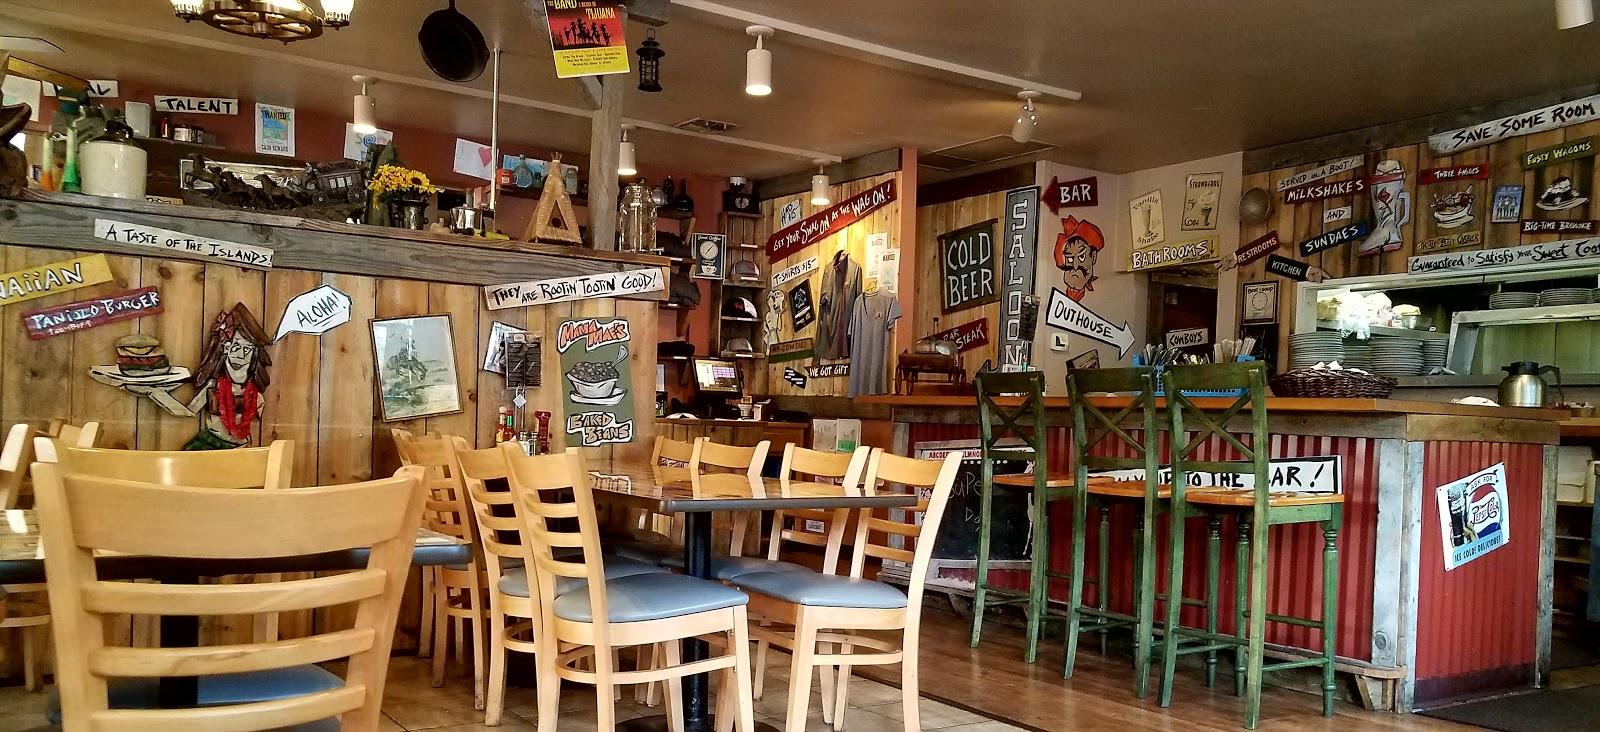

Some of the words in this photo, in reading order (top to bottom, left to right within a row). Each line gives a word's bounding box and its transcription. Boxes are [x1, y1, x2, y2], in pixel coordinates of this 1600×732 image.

[585, 7, 616, 19] TIJUANA
[160, 98, 233, 114] TALENT
[1452, 127, 1492, 148] SAVE
[1499, 112, 1546, 137] SOME
[1551, 102, 1596, 124] ROOM
[1527, 152, 1549, 165] RUSTY
[1280, 174, 1307, 189] SERVED
[1328, 158, 1354, 175] BOOT!
[1060, 184, 1091, 204] BAR
[773, 239, 785, 251] GET
[786, 230, 801, 248] YOUR
[800, 220, 819, 244] SWAG
[820, 215, 831, 234] ON
[831, 211, 839, 221] AT
[839, 204, 851, 215] THE
[851, 194, 870, 217] WAG
[1327, 210, 1346, 220] AND
[105, 224, 117, 242] A
[123, 229, 157, 245] TASTE
[166, 238, 181, 248] OF
[183, 239, 202, 251] THE
[208, 243, 273, 266] ISLANDS!
[1237, 237, 1277, 263] RESTROOMS
[1305, 224, 1359, 252] SUNDAES
[947, 232, 991, 271] COLD
[1132, 240, 1208, 269] BATHROOMS
[1412, 255, 1465, 271] Guaranteed
[1476, 250, 1514, 265] Satisfy
[1272, 260, 1302, 276] KITCHEN
[491, 285, 521, 306] THEY
[521, 290, 538, 304] ARE
[621, 272, 657, 291] GOOD!
[947, 268, 993, 308] BEER
[1005, 200, 1028, 365] SALOON
[100, 291, 160, 315] BURGER
[296, 292, 346, 327] ALOHA!
[1055, 301, 1114, 339] OUTHOUSE
[560, 321, 599, 348] MAMA
[955, 323, 986, 350] STEAK
[1169, 331, 1203, 349] COWBOYS
[809, 367, 819, 377] WE
[820, 366, 832, 376] GOT
[569, 414, 613, 430] BAKED
[585, 424, 629, 444] BEANS
[1471, 479, 1482, 491] ASK
[1483, 475, 1493, 483] FOR
